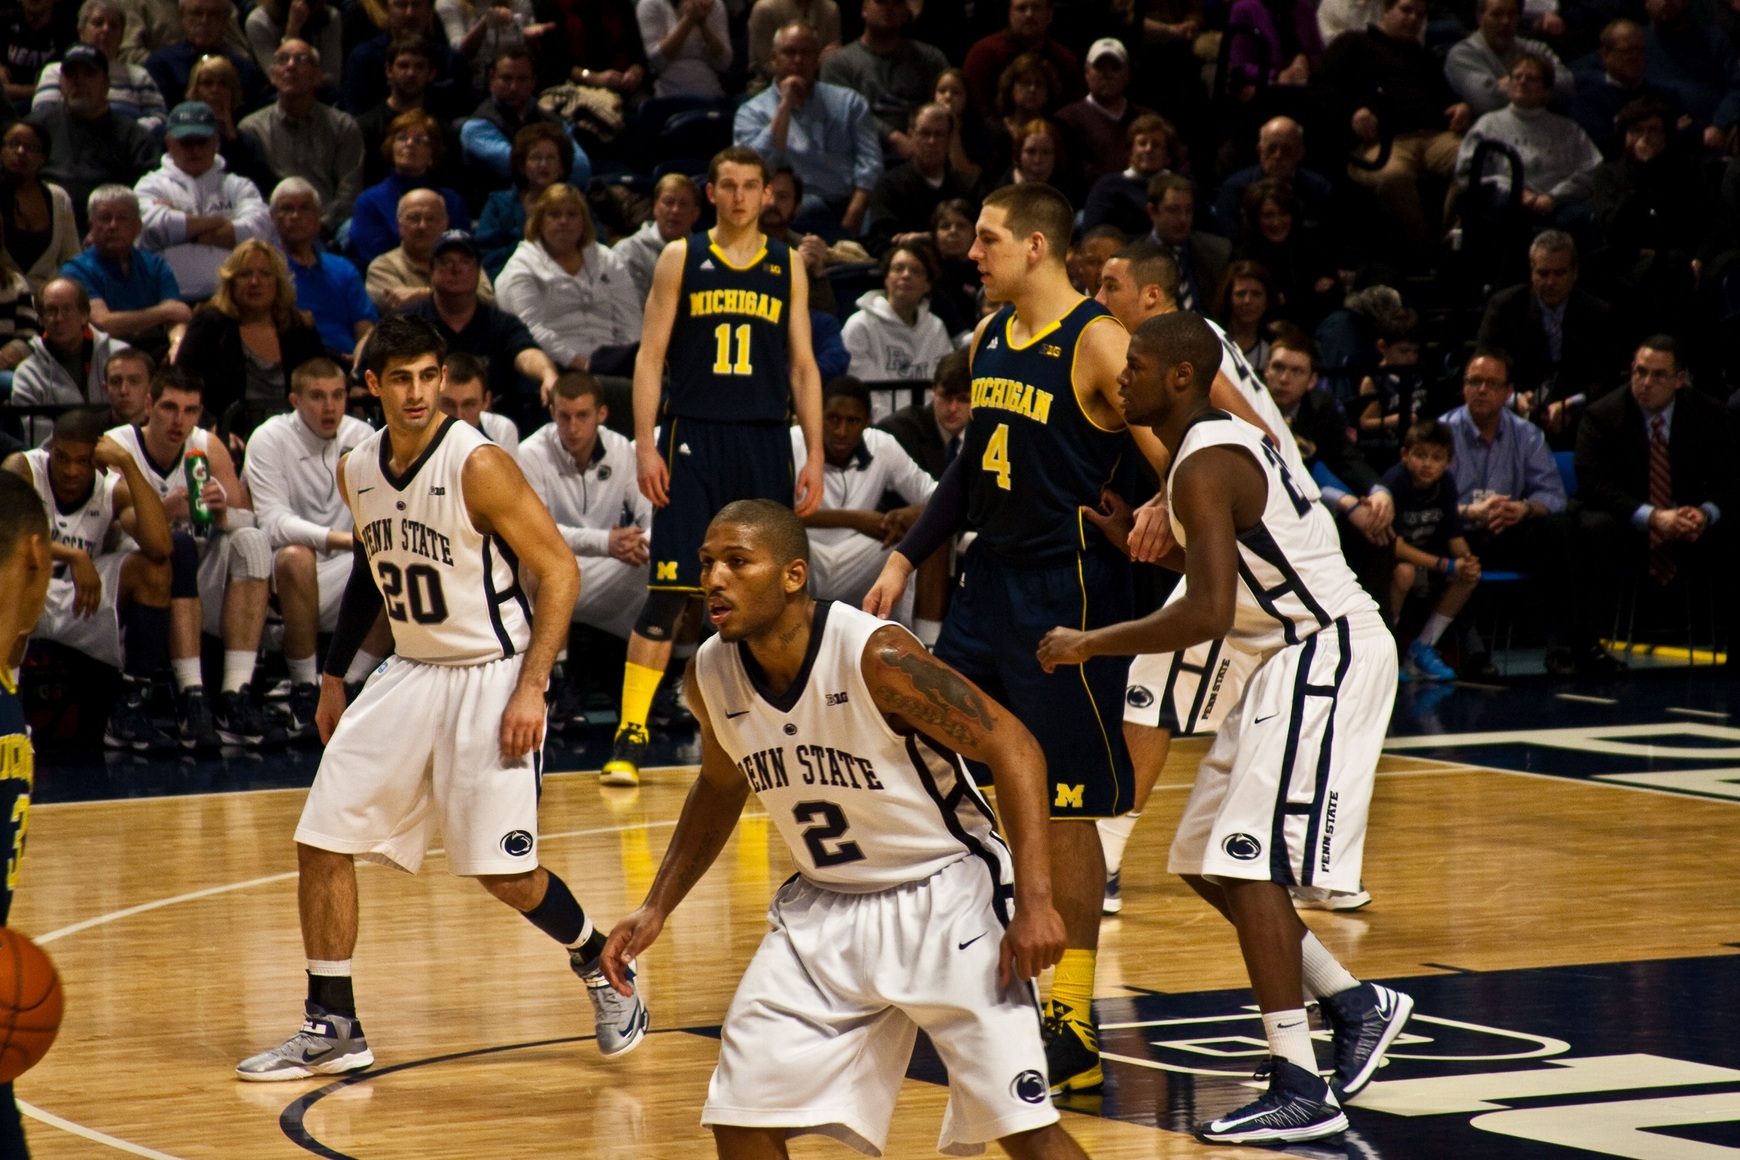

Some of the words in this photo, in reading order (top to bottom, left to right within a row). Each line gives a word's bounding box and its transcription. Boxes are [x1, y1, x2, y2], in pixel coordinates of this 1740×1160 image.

[690, 289, 783, 325] MICHIGAN
[712, 322, 752, 375] 11
[982, 423, 1012, 491] 4
[401, 518, 454, 567] STATE
[377, 560, 449, 624] 20
[657, 561, 678, 580] M
[825, 691, 849, 706] B1G
[795, 744, 885, 790] STATE
[1055, 783, 1085, 808] M
[1325, 790, 1339, 834] STATE
[791, 799, 868, 870] 2
[1321, 835, 1332, 872] PENN
